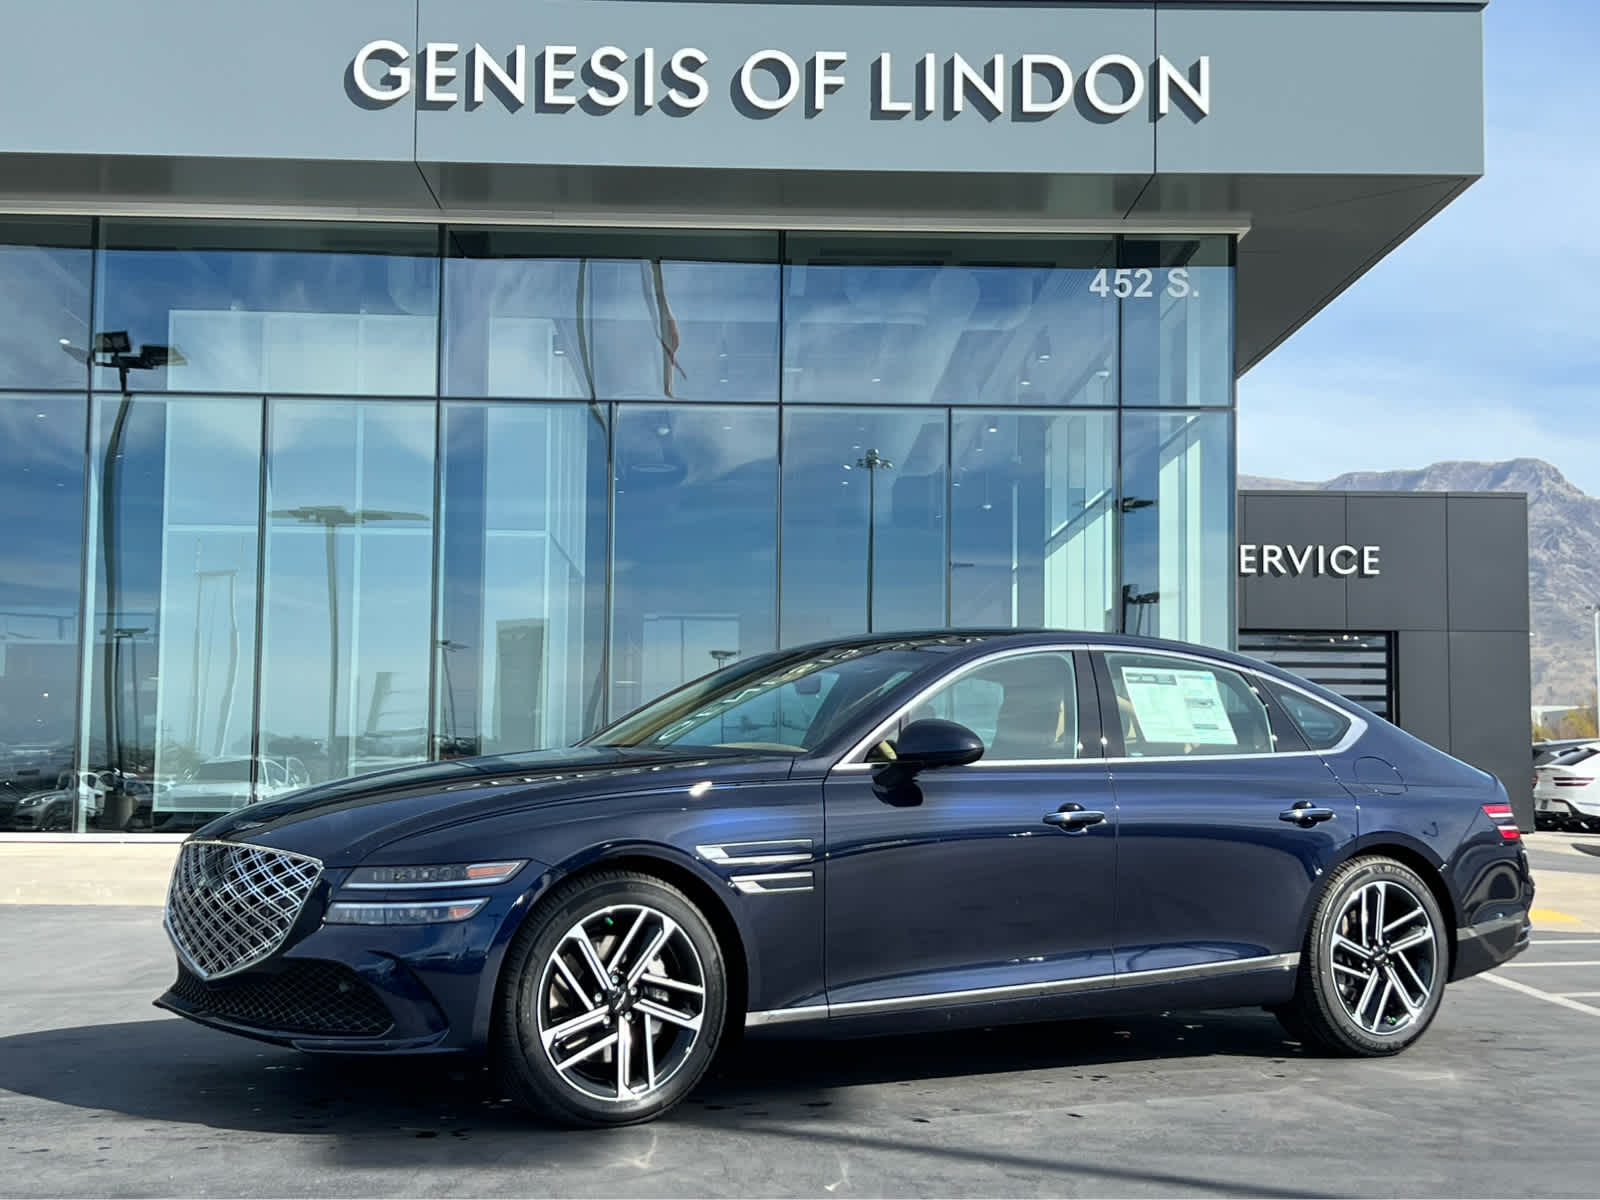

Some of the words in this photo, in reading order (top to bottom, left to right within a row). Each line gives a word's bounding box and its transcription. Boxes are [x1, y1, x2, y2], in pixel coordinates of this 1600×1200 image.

[353, 40, 709, 109] GENESIS
[740, 49, 847, 110] OF
[880, 51, 1210, 116] LINDON
[1088, 268, 1153, 298] 452
[1167, 267, 1200, 298] S.
